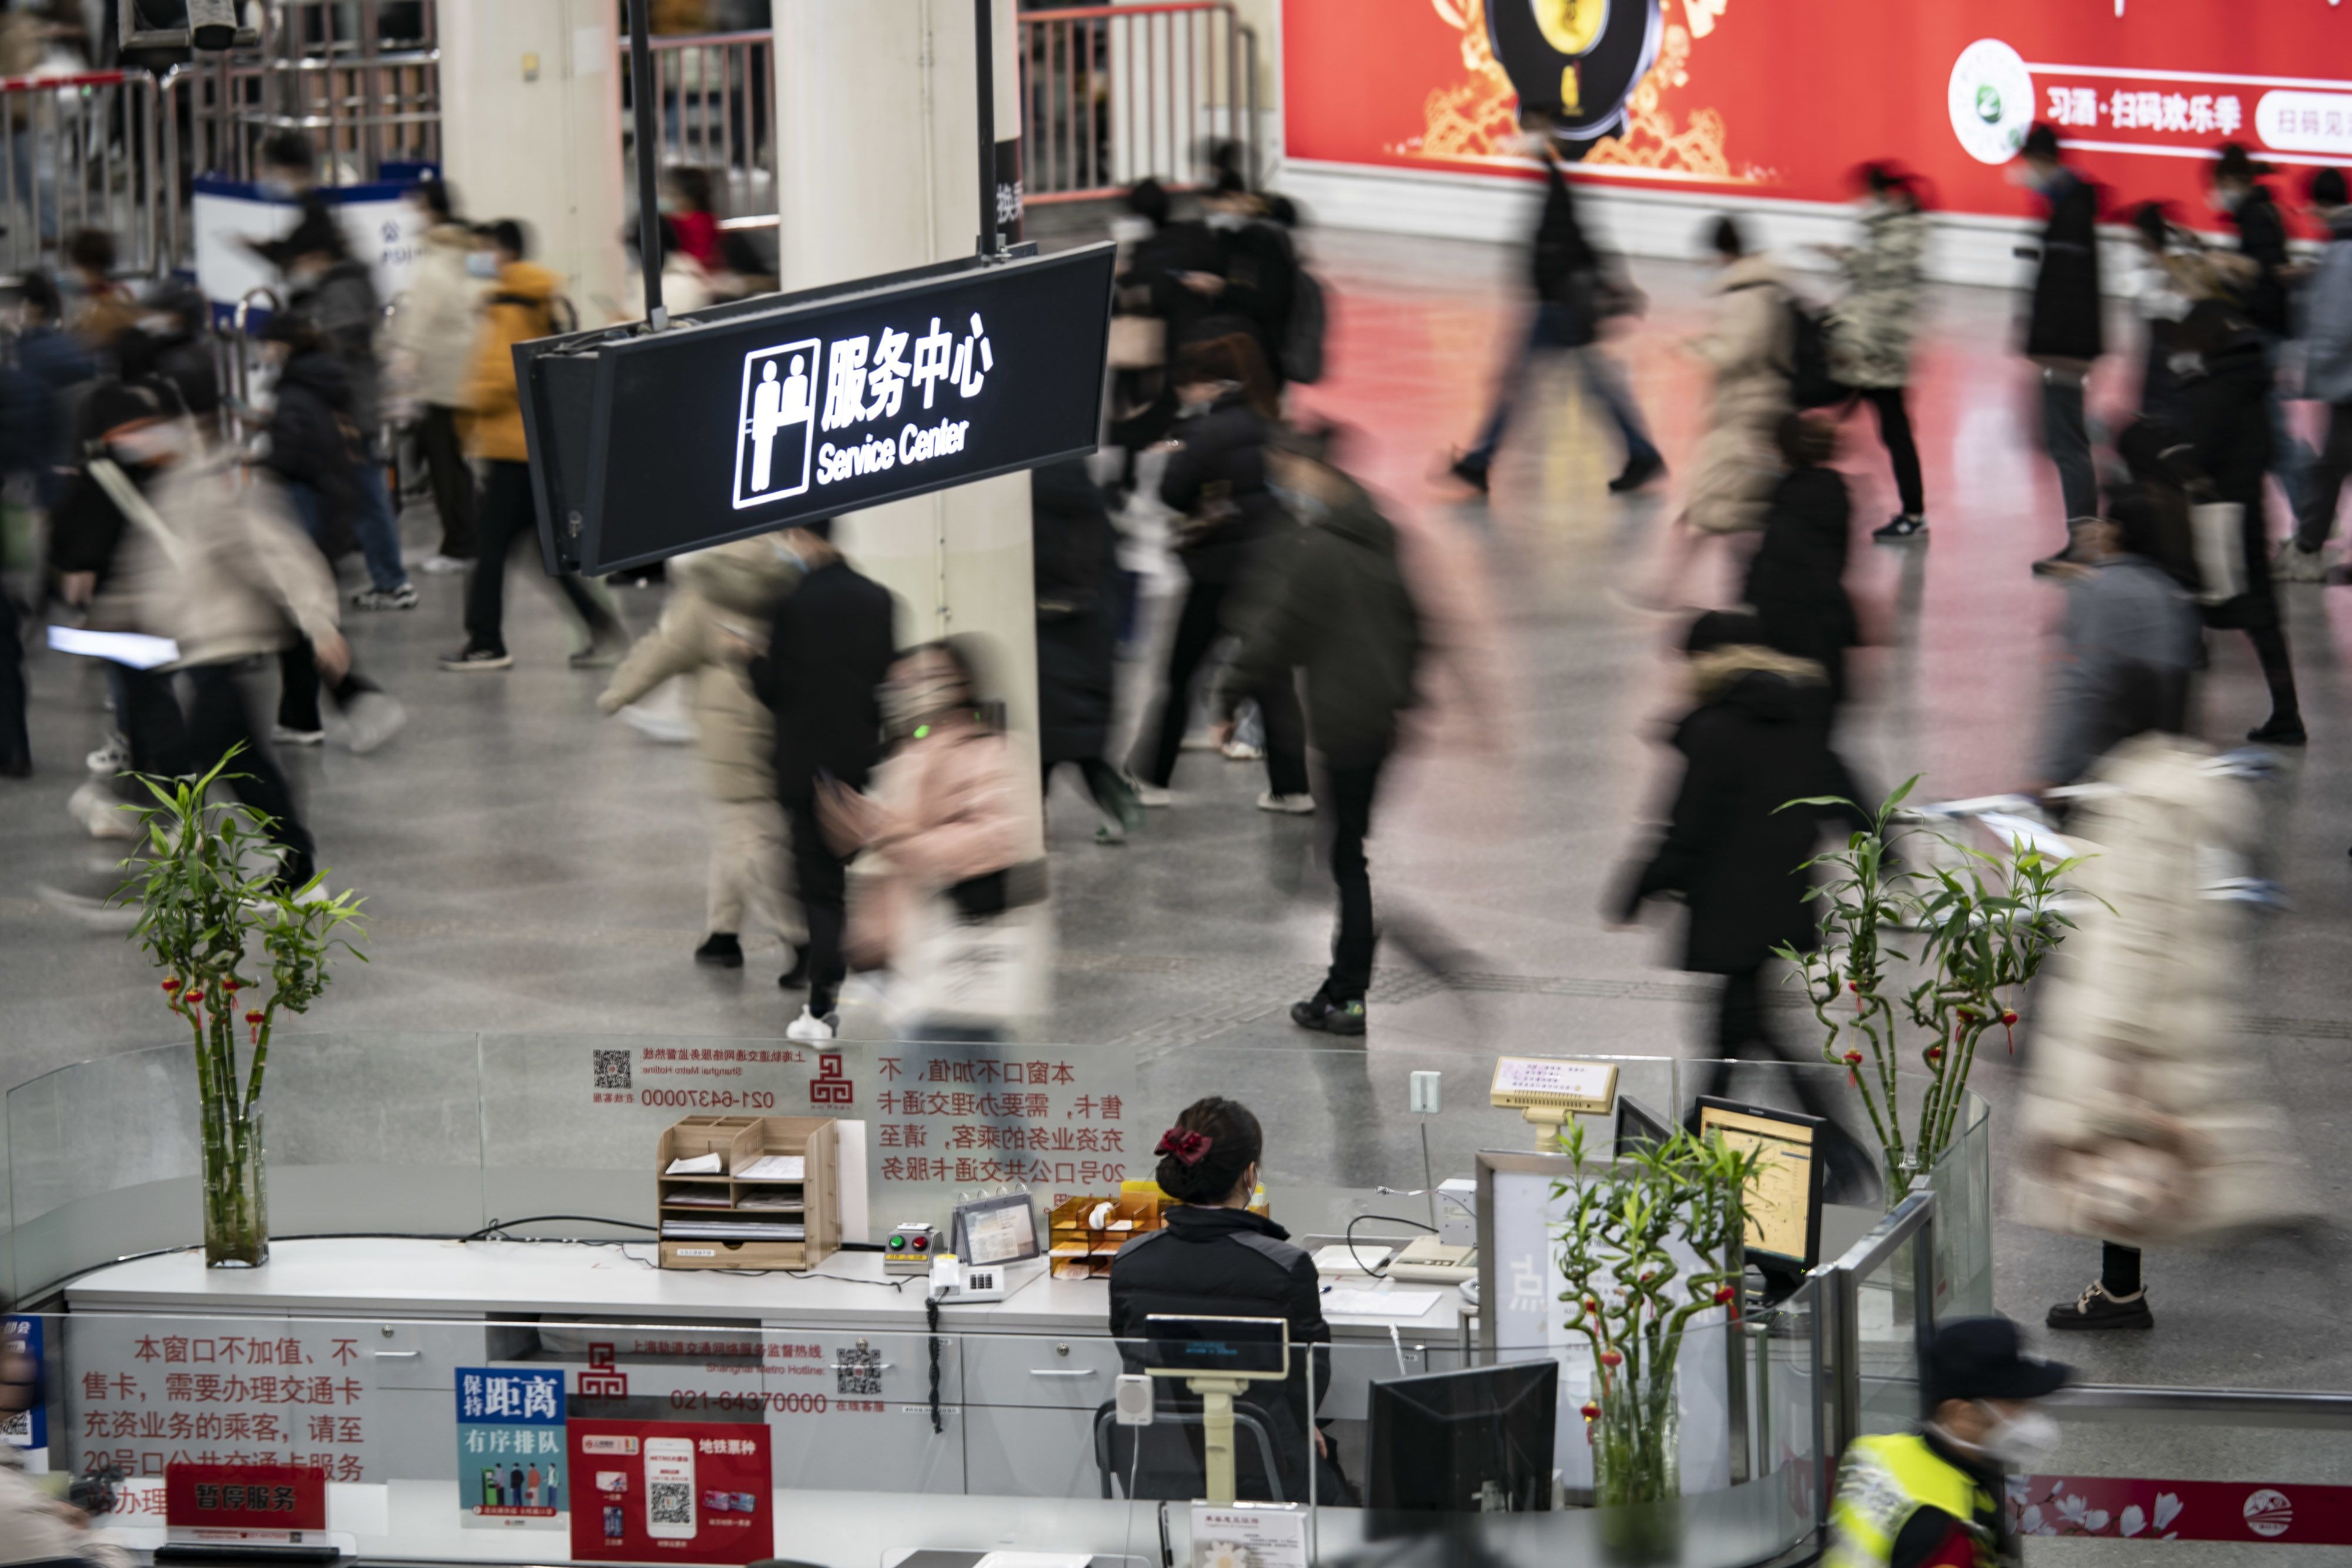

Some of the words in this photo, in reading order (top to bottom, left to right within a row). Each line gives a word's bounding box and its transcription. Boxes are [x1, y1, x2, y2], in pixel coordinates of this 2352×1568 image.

[821, 312, 993, 432] 服务中心
[817, 434, 894, 485] Service
[899, 418, 969, 465] Center
[135, 1335, 358, 1367] 本窗口不加值、不
[706, 1363, 753, 1376] Shanghai
[82, 1370, 363, 1405] 售卡，需要办理交通卡
[463, 1374, 483, 1417] 保持
[485, 1376, 558, 1419] 距离
[670, 1389, 827, 1413] 021-64370000
[83, 1411, 364, 1444] 充资业务的乘客，请至
[465, 1429, 560, 1455] 有序排队
[699, 1438, 757, 1456] 地铁票种
[196, 1483, 296, 1513] 暂停服务
